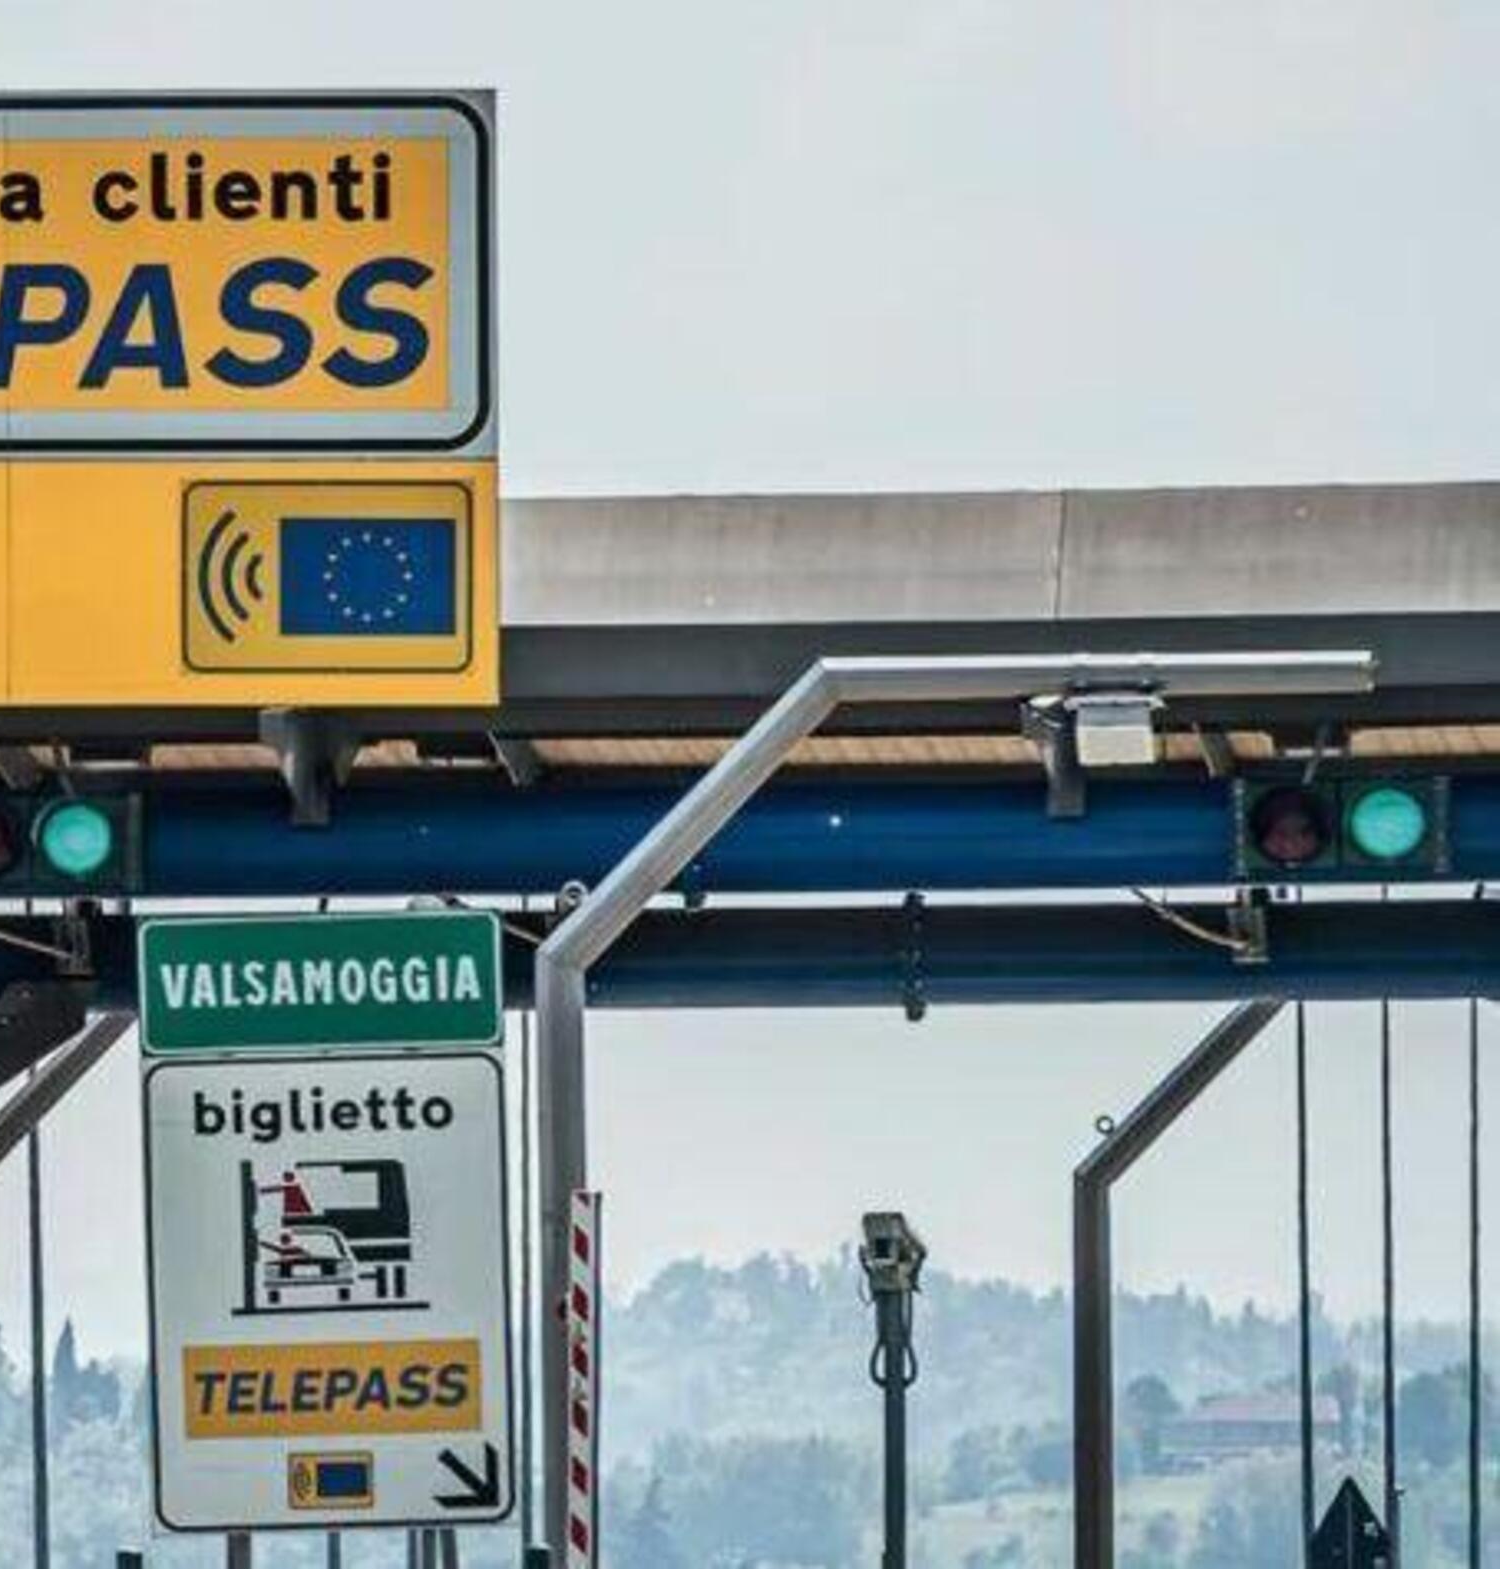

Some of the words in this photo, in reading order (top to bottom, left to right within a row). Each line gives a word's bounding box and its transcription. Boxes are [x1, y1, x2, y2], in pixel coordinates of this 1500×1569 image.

[92, 150, 393, 224] clienti
[160, 954, 482, 1010] VALSAMOGGIA
[192, 1085, 455, 1145] biglietto
[192, 1361, 471, 1418] TELEPASS
